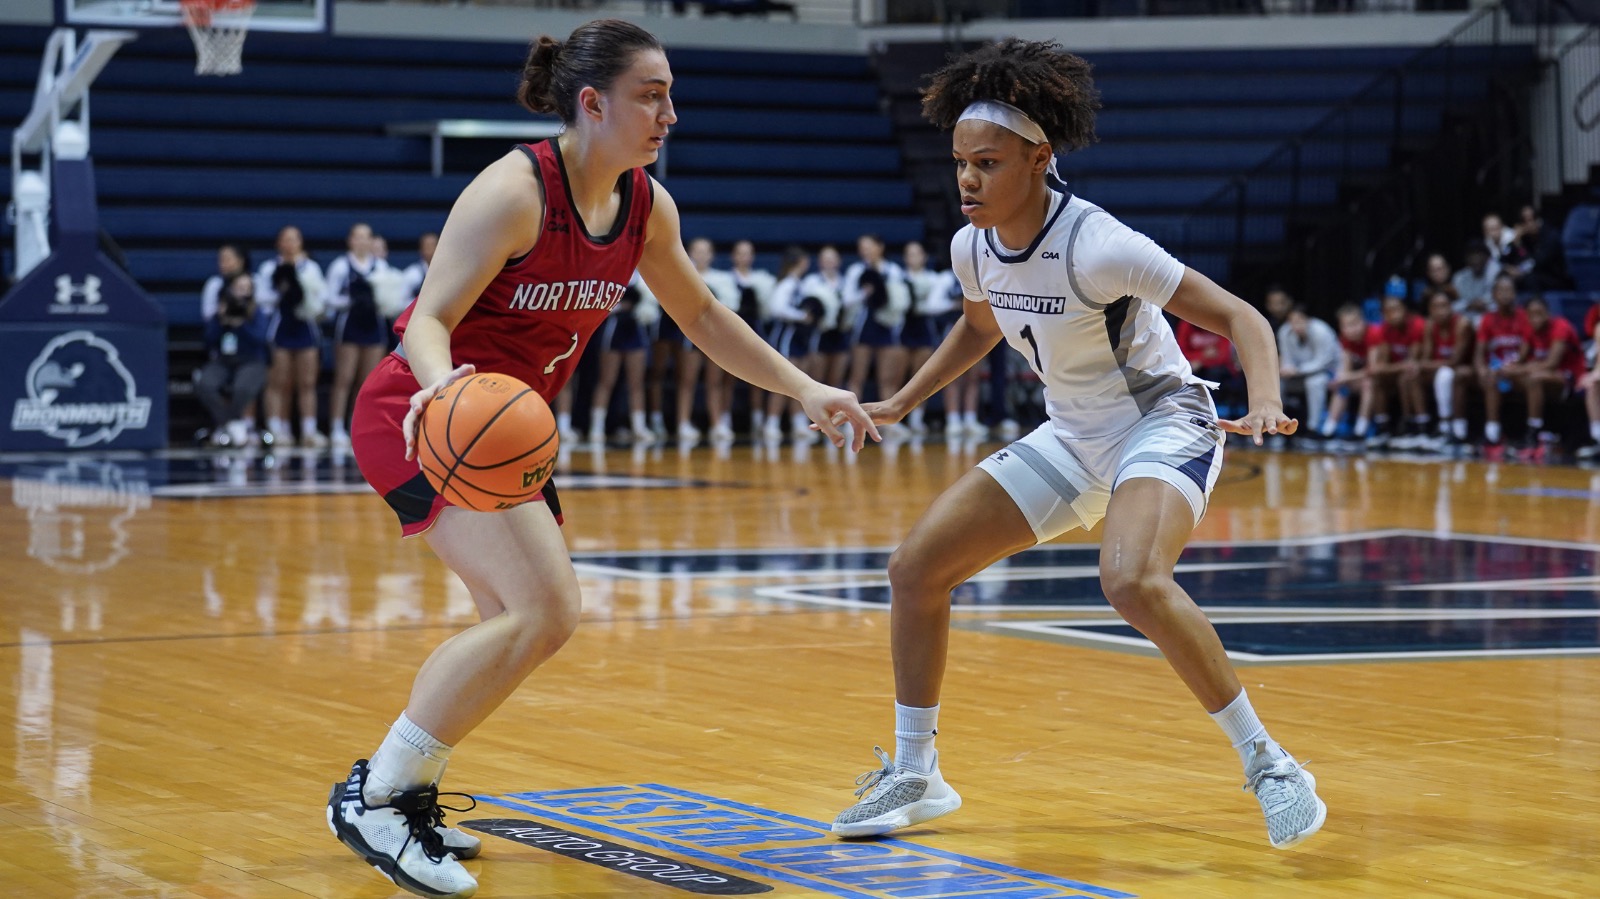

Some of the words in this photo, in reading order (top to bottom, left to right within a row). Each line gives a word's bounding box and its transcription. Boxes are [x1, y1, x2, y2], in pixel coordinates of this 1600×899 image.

[1041, 251, 1060, 260] CAA
[987, 290, 1065, 314] MONMOUTH
[543, 332, 578, 375] 1
[1019, 323, 1045, 375] 1
[18, 402, 147, 427] MONMOUTH
[500, 785, 826, 848] LESTER
[491, 826, 603, 851] AUTO
[584, 850, 729, 885] GROUP
